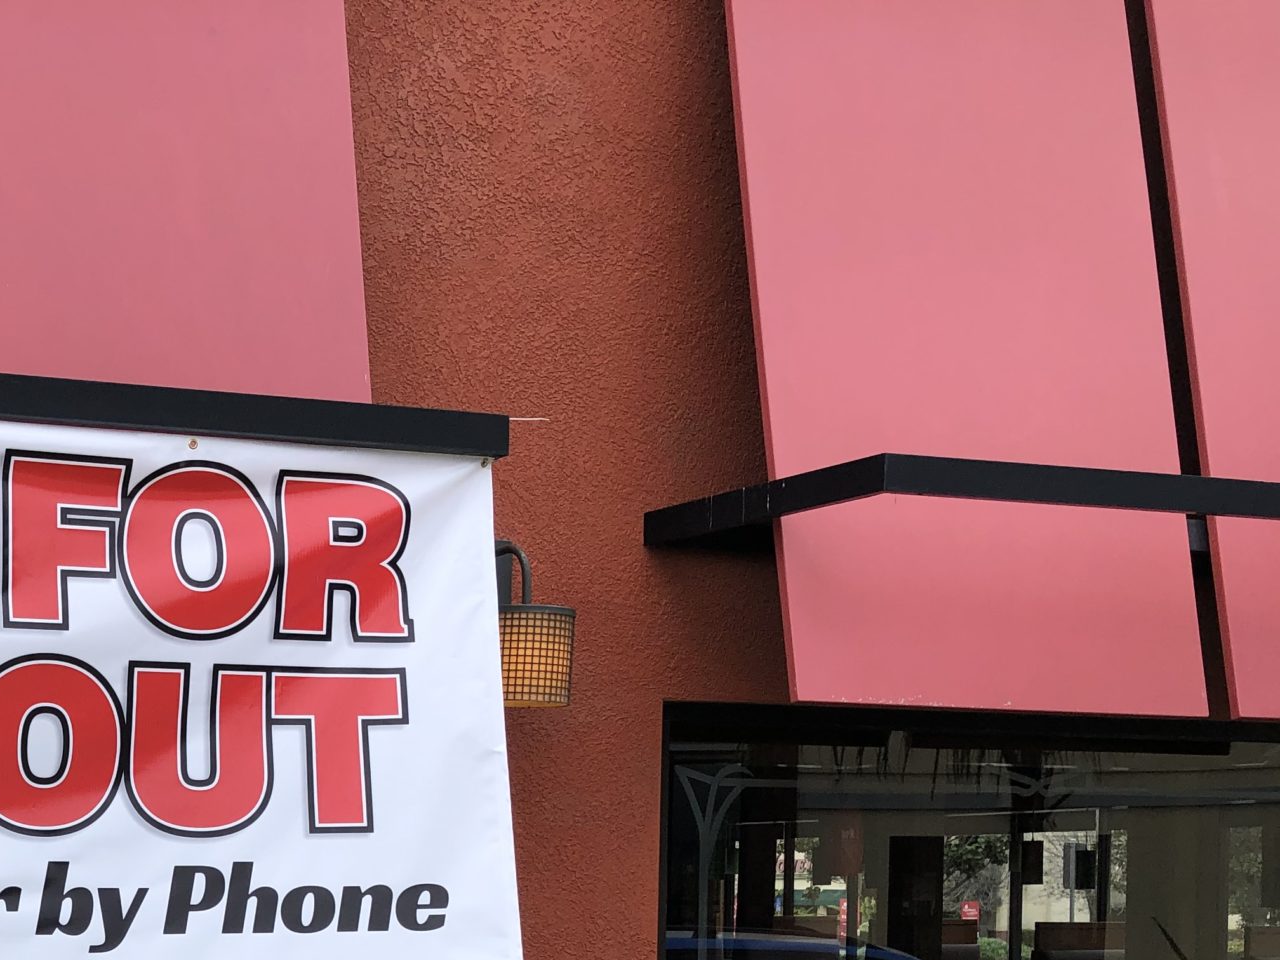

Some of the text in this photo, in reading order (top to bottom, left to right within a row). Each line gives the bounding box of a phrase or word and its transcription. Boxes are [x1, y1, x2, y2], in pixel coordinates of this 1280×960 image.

[2, 447, 415, 642] FOR
[34, 861, 149, 953] by
[162, 861, 449, 935] Phone
